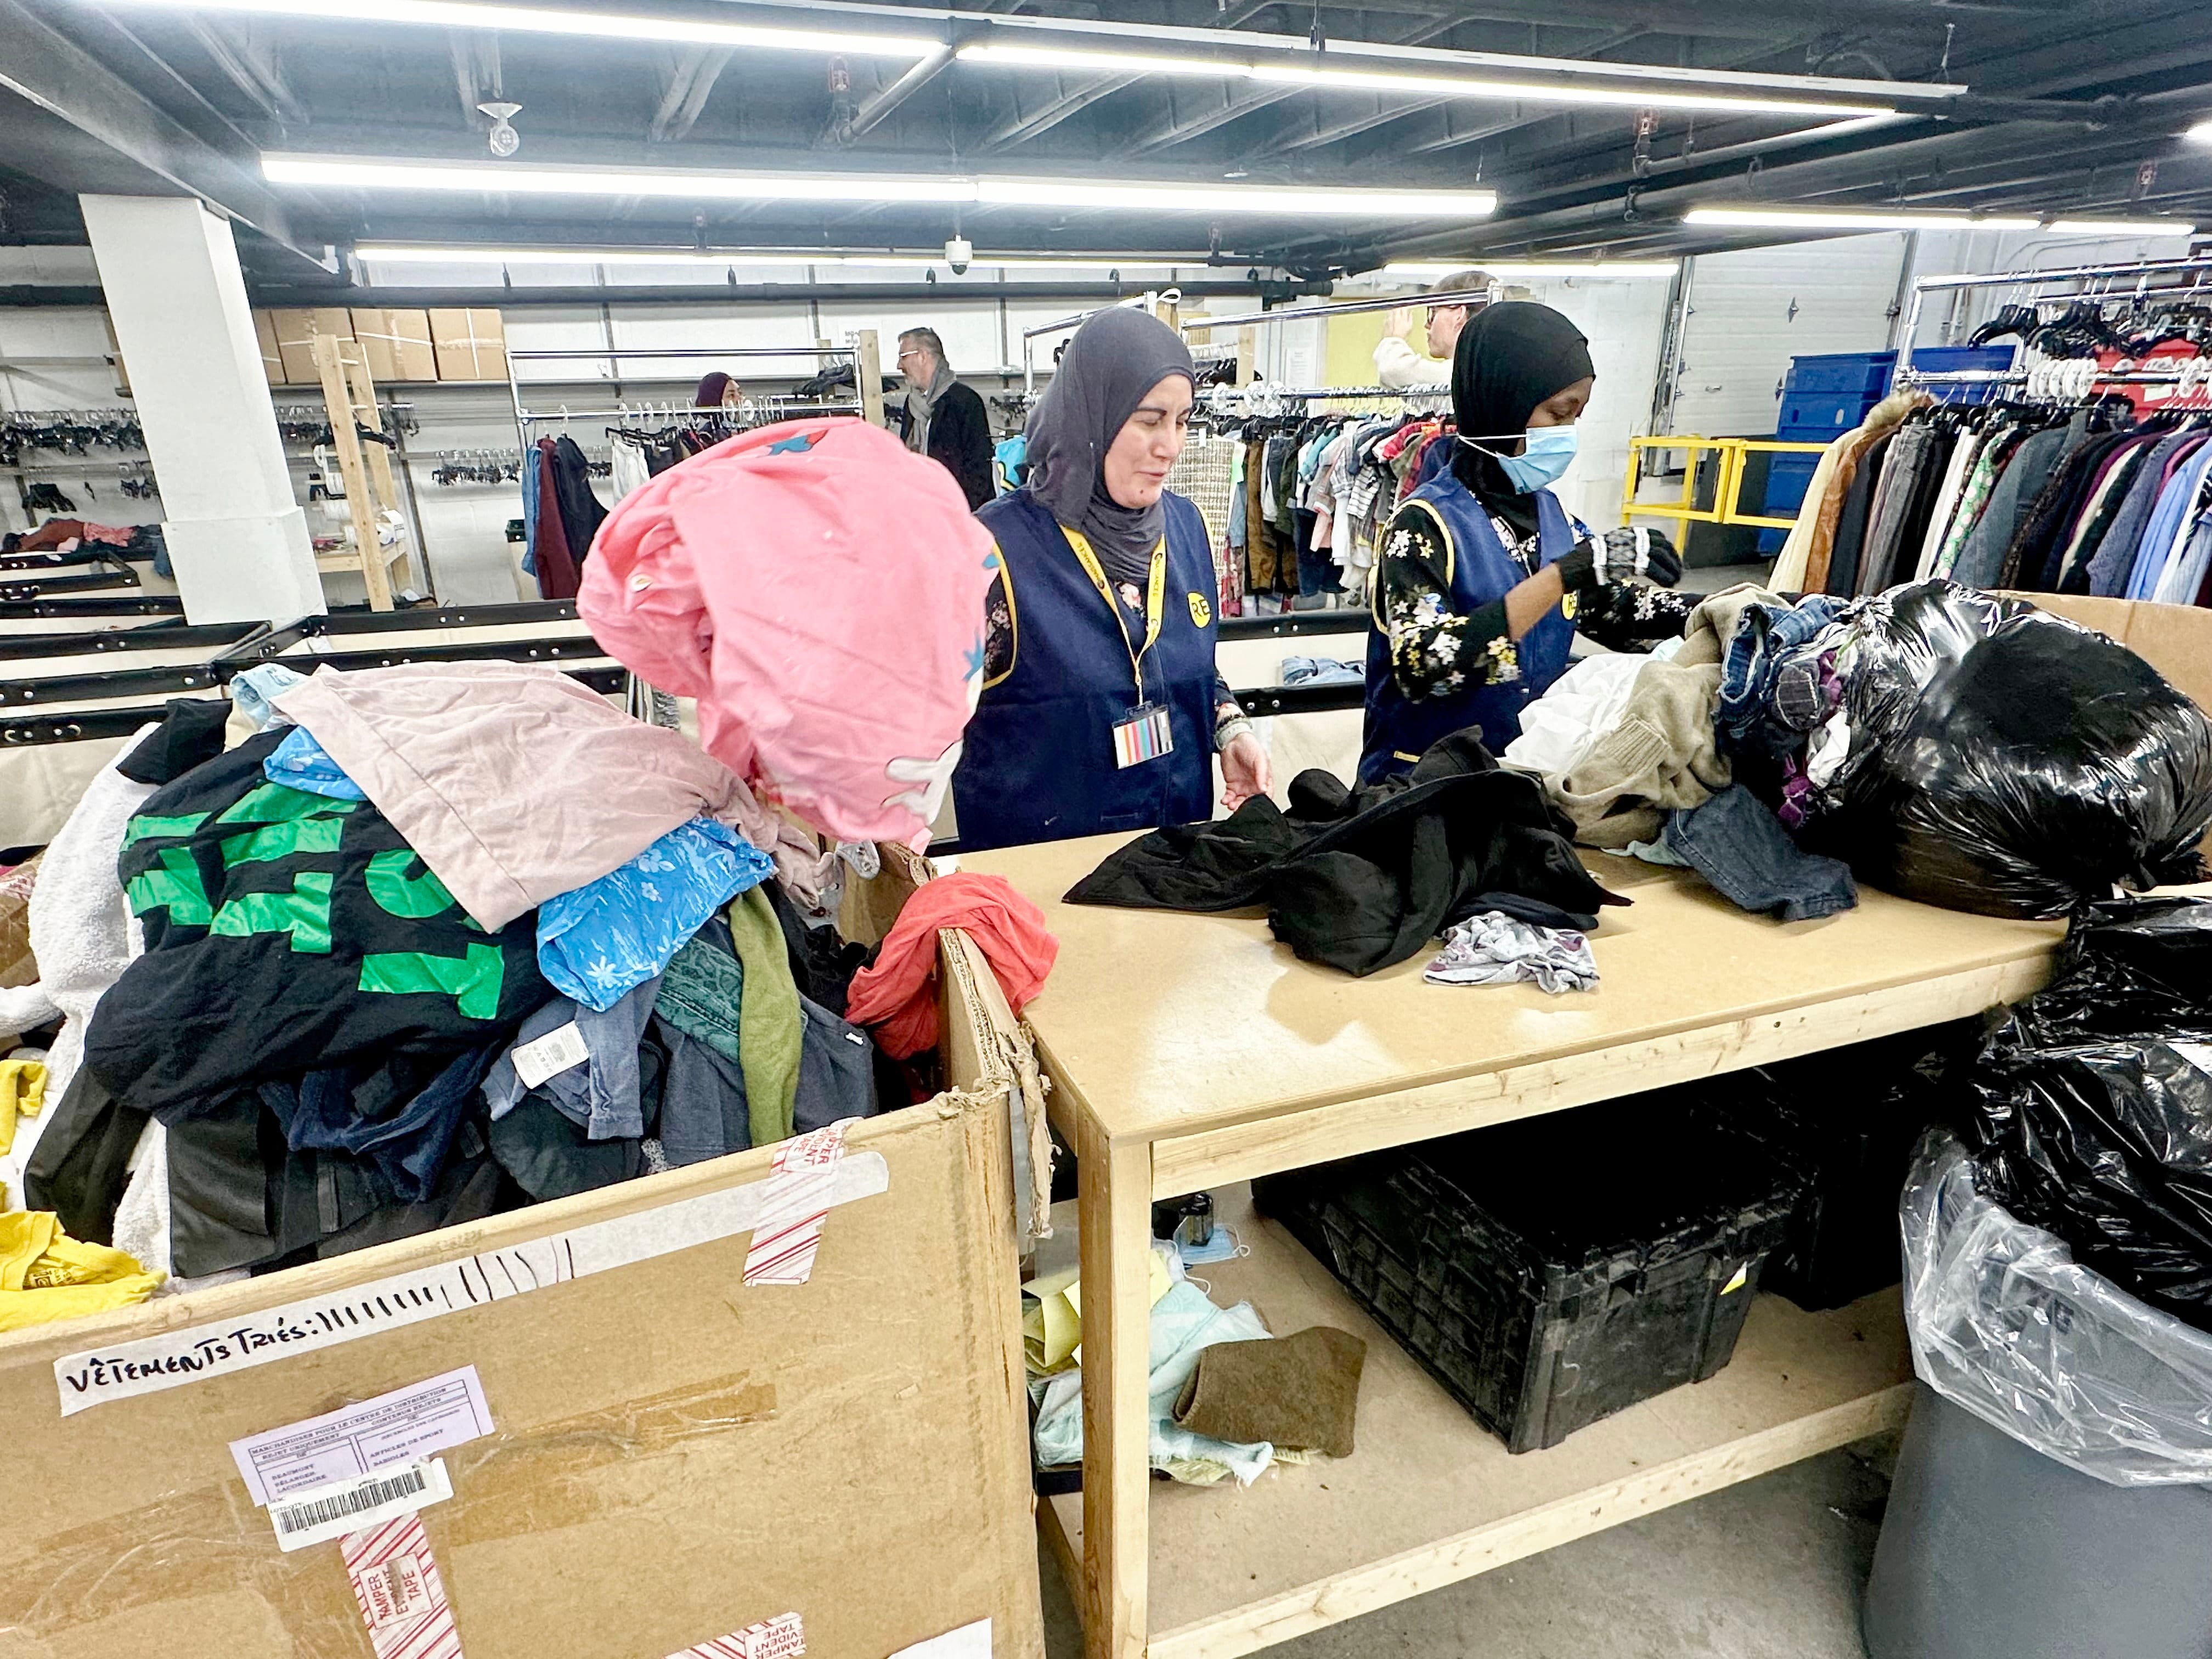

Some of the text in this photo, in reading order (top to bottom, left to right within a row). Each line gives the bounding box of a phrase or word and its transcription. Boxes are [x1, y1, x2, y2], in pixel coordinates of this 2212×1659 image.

[1192, 600, 1209, 618] RE
[315, 1425, 336, 1436] POUR
[368, 1572, 393, 1620] TAMPER
[402, 1570, 422, 1602] TAPE
[753, 1628, 804, 1654] EVIDENT
[763, 1623, 796, 1640] TAPE
